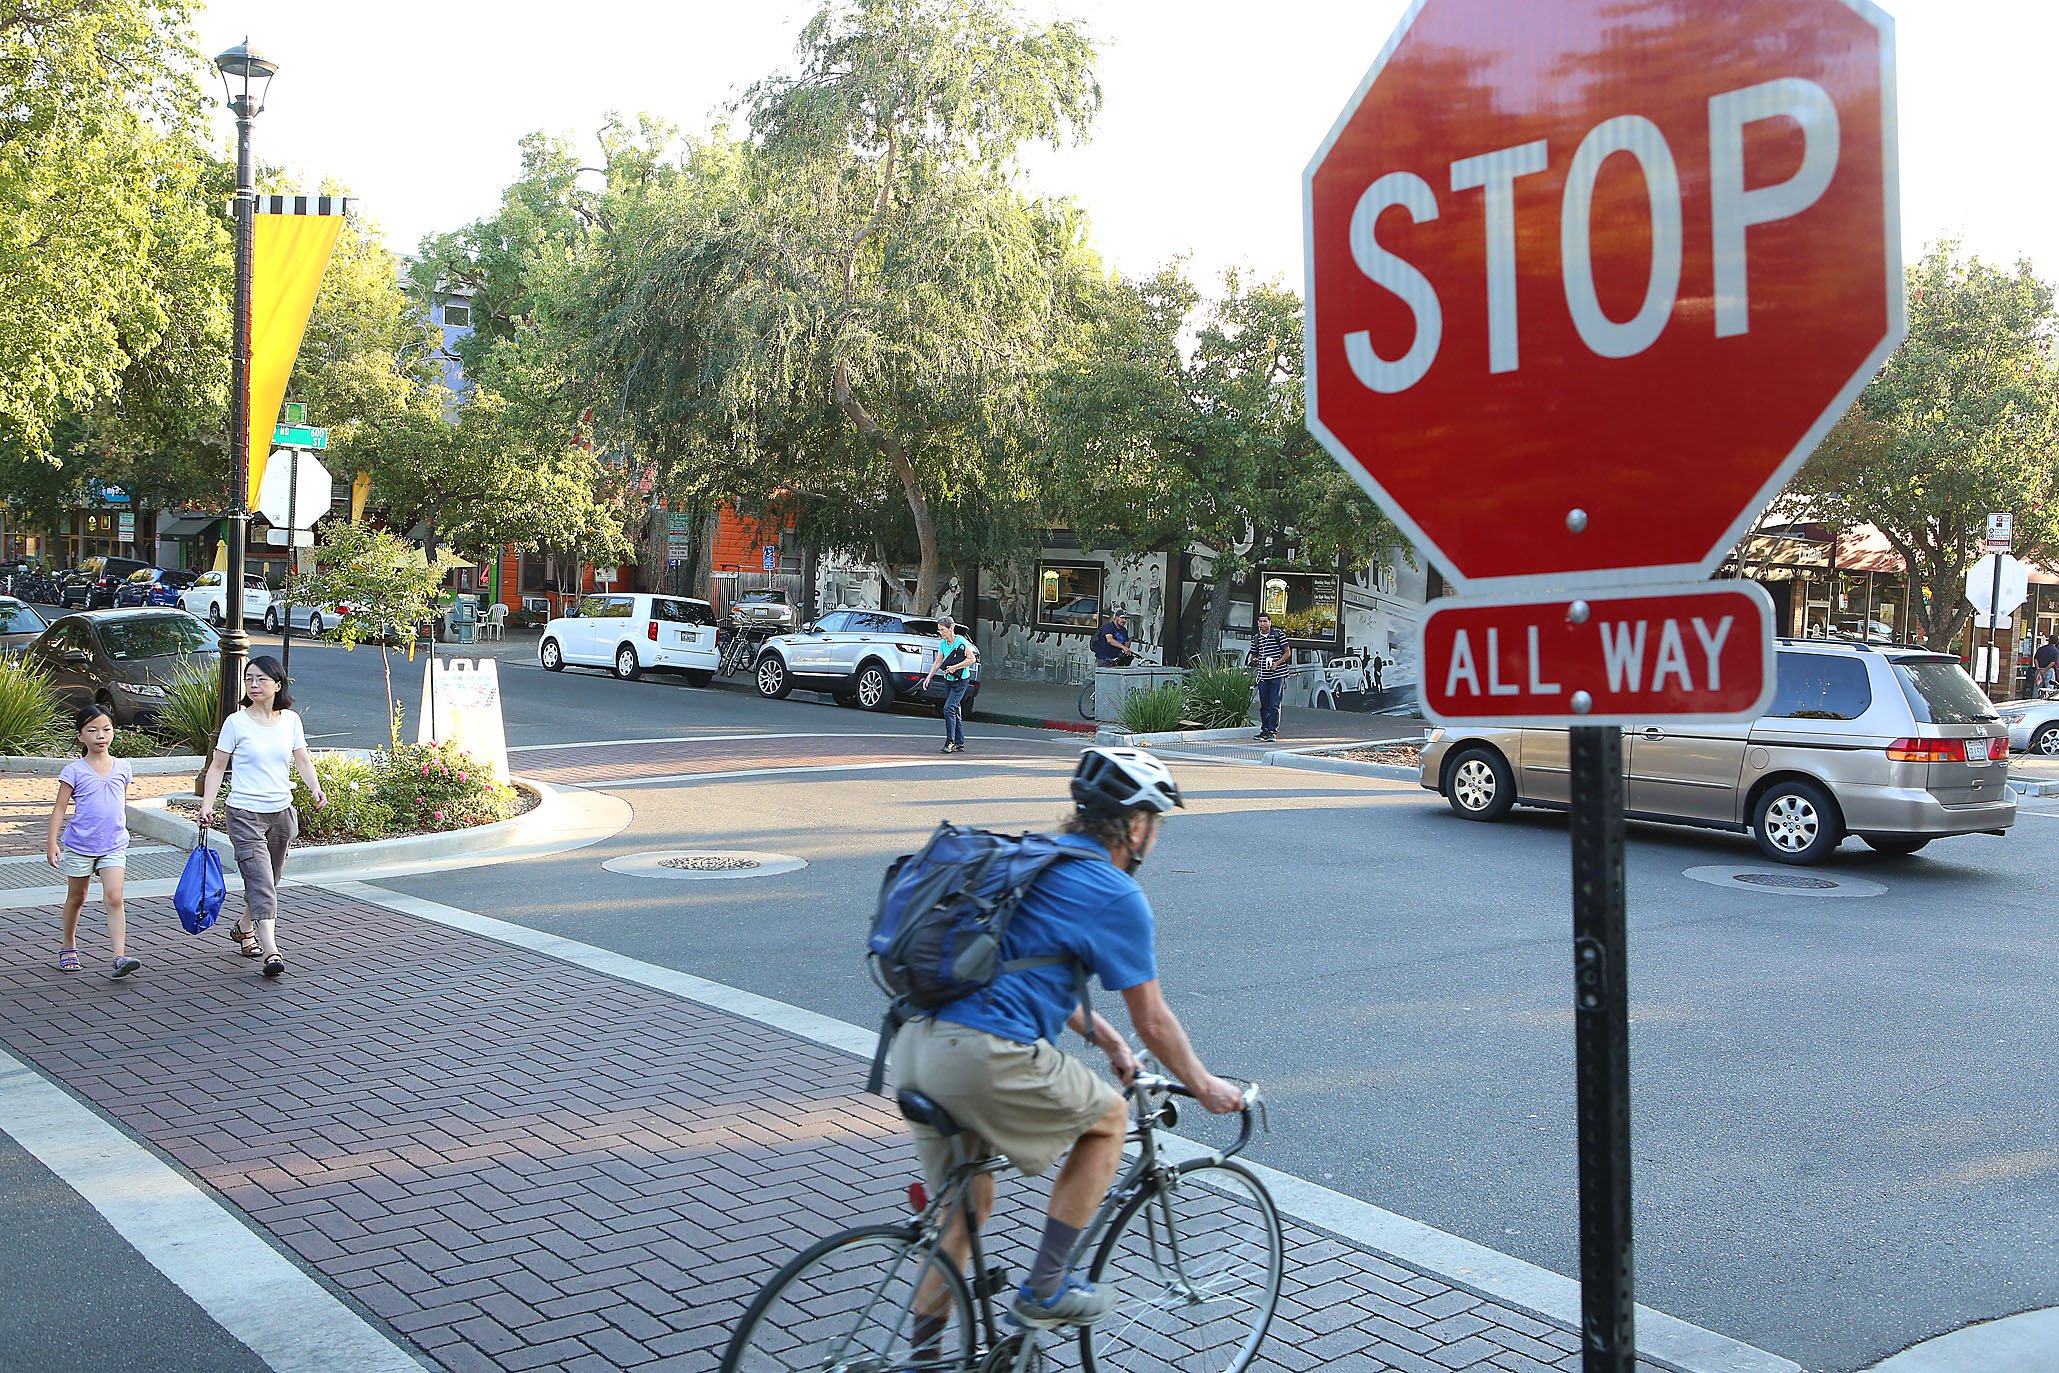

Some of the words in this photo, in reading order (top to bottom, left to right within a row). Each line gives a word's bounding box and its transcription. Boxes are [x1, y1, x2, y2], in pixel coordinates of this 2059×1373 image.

[1344, 76, 1841, 394] STOP
[310, 428, 325, 438] 600
[312, 438, 322, 447] ST
[1354, 558, 1398, 596] CLUB
[1445, 625, 1562, 697] ALL
[1599, 615, 1734, 693] WAY
